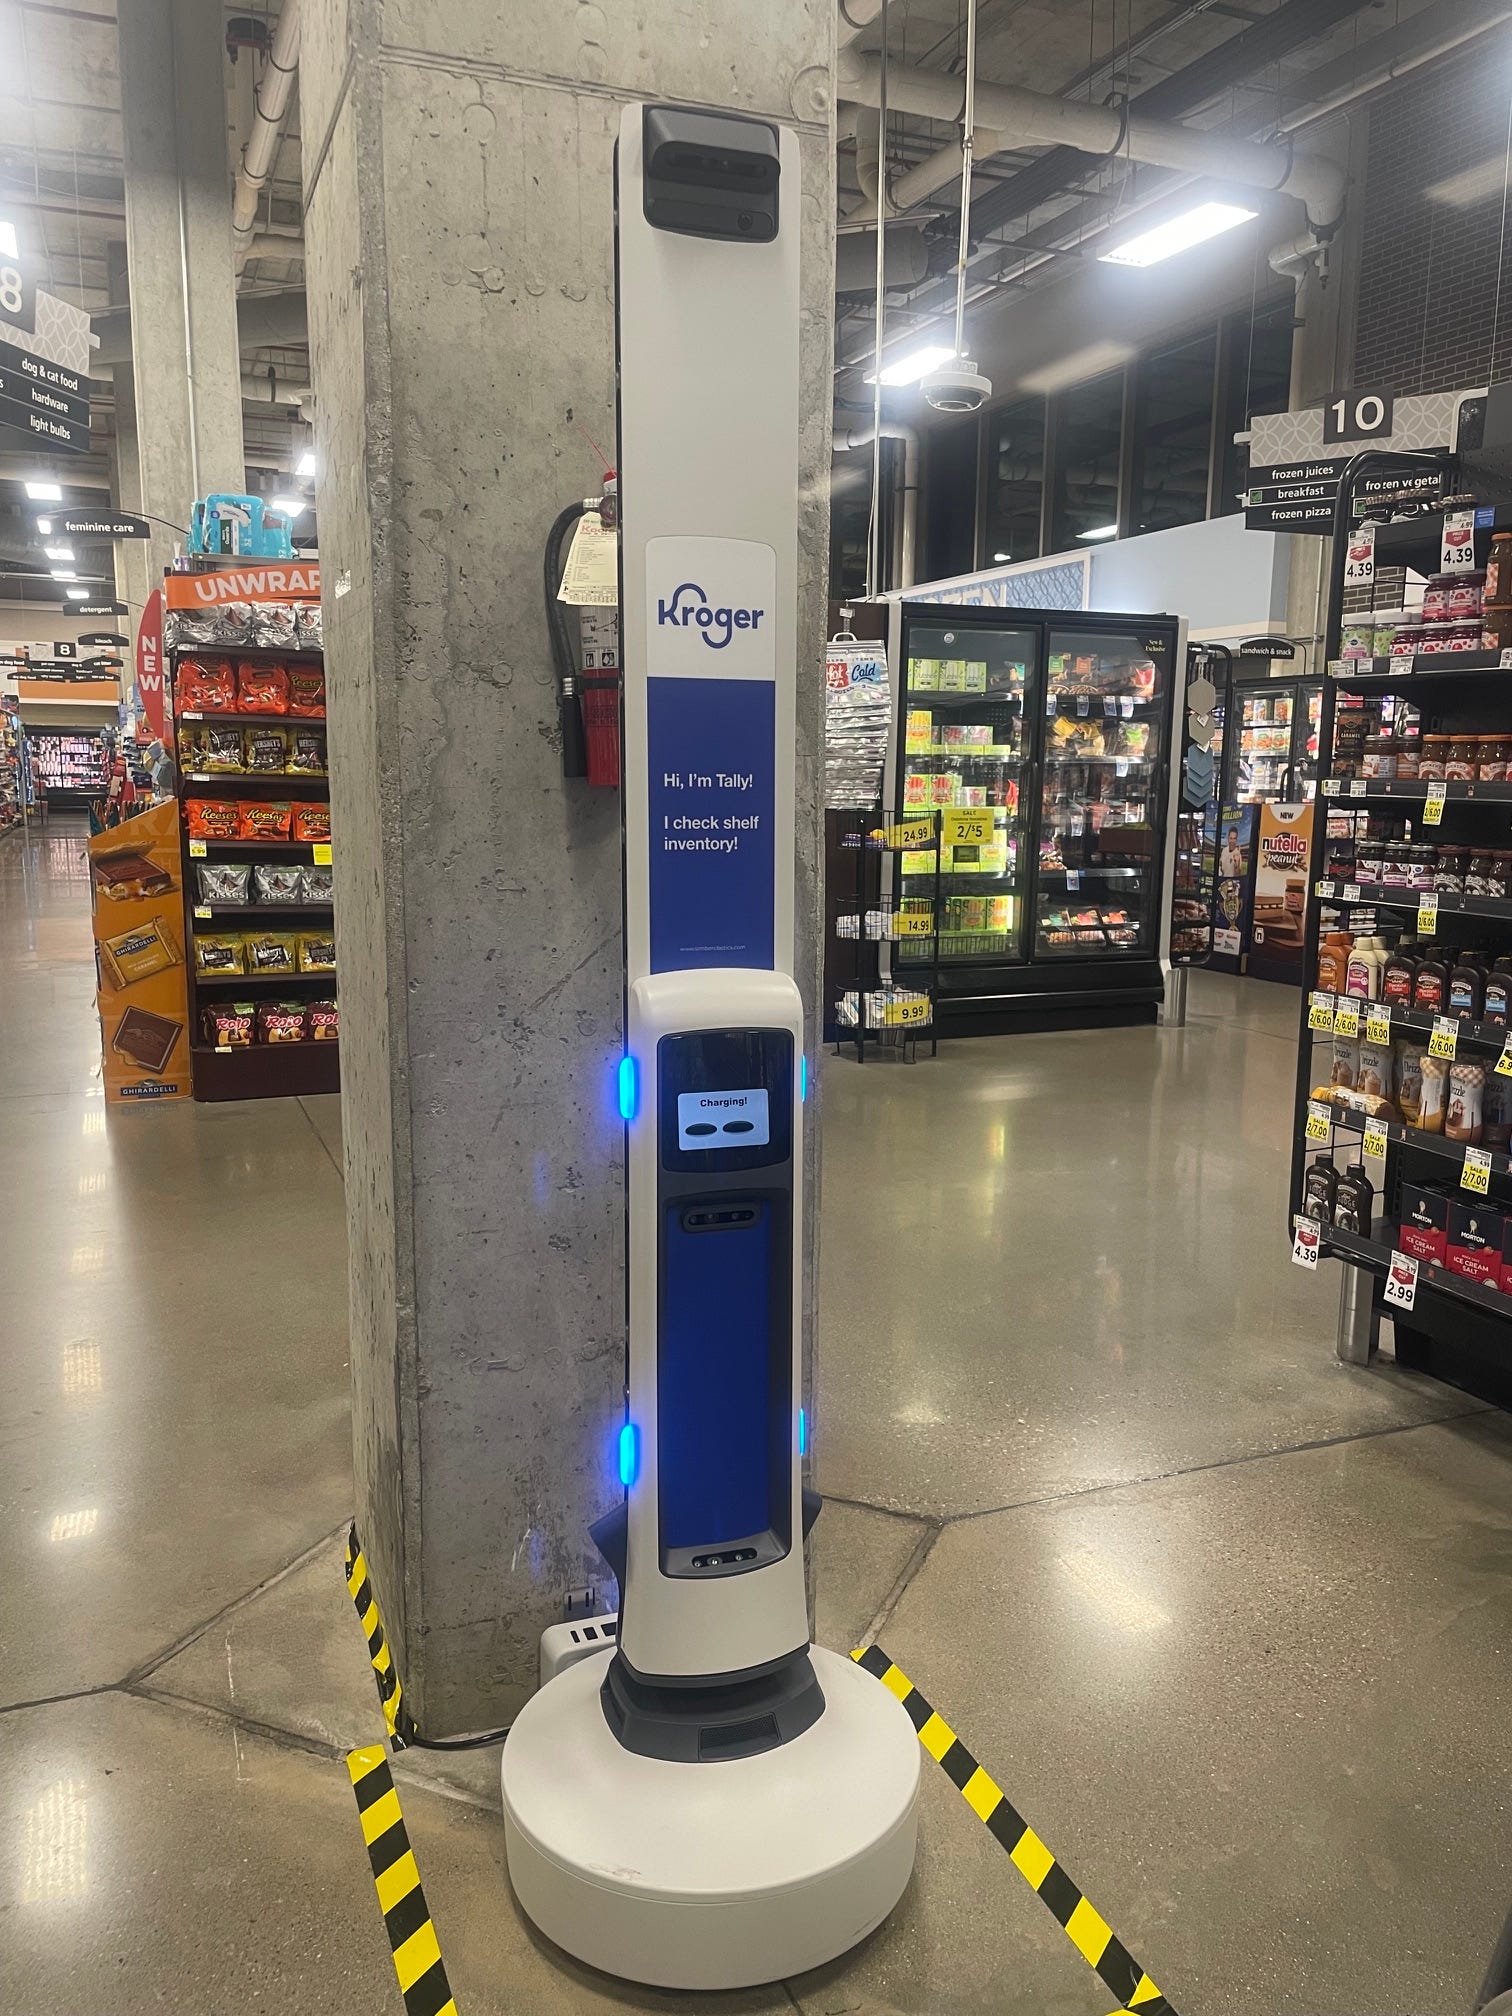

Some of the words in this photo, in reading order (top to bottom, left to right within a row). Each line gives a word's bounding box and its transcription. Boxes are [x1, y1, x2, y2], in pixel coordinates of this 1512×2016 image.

[0, 267, 22, 313] 8
[22, 358, 37, 377] dog
[39, 365, 46, 378] &
[47, 371, 59, 384] cat
[60, 373, 78, 390] food
[31, 388, 69, 413] hardware
[1331, 395, 1385, 433] 10
[30, 414, 48, 432] light
[49, 421, 71, 440] bulbs
[1271, 469, 1303, 480] frozen
[1304, 466, 1334, 479] juices
[1277, 486, 1325, 499] breakfast
[1271, 509, 1303, 520] frozen
[1304, 507, 1332, 519] pizza
[65, 521, 111, 532] feminine
[112, 525, 134, 533] care
[1443, 547, 1473, 564] 4.39
[1347, 562, 1373, 577] 4.39
[80, 606, 113, 614] detergent
[658, 583, 764, 649] Kroger
[59, 644, 71, 655] 8
[1241, 646, 1270, 655] sandwich
[1276, 648, 1292, 656] snack
[140, 635, 161, 692] NEW
[851, 662, 876, 682] Cold
[663, 773, 684, 789] Hi,
[688, 773, 712, 787] I'm
[716, 774, 753, 791] Tally!
[200, 806, 237, 820] Reese's
[1279, 811, 1294, 820] NEW
[664, 815, 669, 830] I
[673, 815, 720, 830] check
[723, 815, 760, 830] shelf
[904, 827, 928, 843] 24.99
[957, 824, 983, 840] 2/$5
[664, 836, 738, 853] inventory!
[1262, 834, 1307, 853] nutella
[1266, 852, 1300, 866] peanut
[908, 920, 929, 931] 14.99
[1418, 916, 1435, 928] 2/6.00
[115, 936, 158, 956] GHIRARDELLI
[902, 1005, 924, 1019] 9.99
[1310, 1013, 1332, 1026] 2/6.00
[1335, 1018, 1357, 1031] 2/6.00
[1368, 1025, 1388, 1039] 2/6.00
[1437, 1033, 1450, 1041] SALE
[1429, 1039, 1454, 1054] 2/6.00
[122, 1085, 177, 1095] GHIRARDELLI
[700, 1096, 748, 1108] Charging!
[1307, 1122, 1328, 1137] 2/7.00
[1364, 1139, 1384, 1154] 2/7.00
[1470, 1165, 1483, 1174] SALE
[1462, 1170, 1487, 1187] 2/7.00
[1411, 1212, 1432, 1224] MORTON
[1405, 1236, 1415, 1244] ICE
[1414, 1239, 1435, 1252] CREAM
[1460, 1231, 1486, 1244] MORTON
[1295, 1245, 1317, 1263] 4.39
[1412, 1245, 1427, 1254] SALT
[1453, 1256, 1464, 1265] ICE
[1464, 1259, 1489, 1272] CREAM
[1462, 1265, 1479, 1275] SALT
[1386, 1281, 1414, 1302] 2.99
